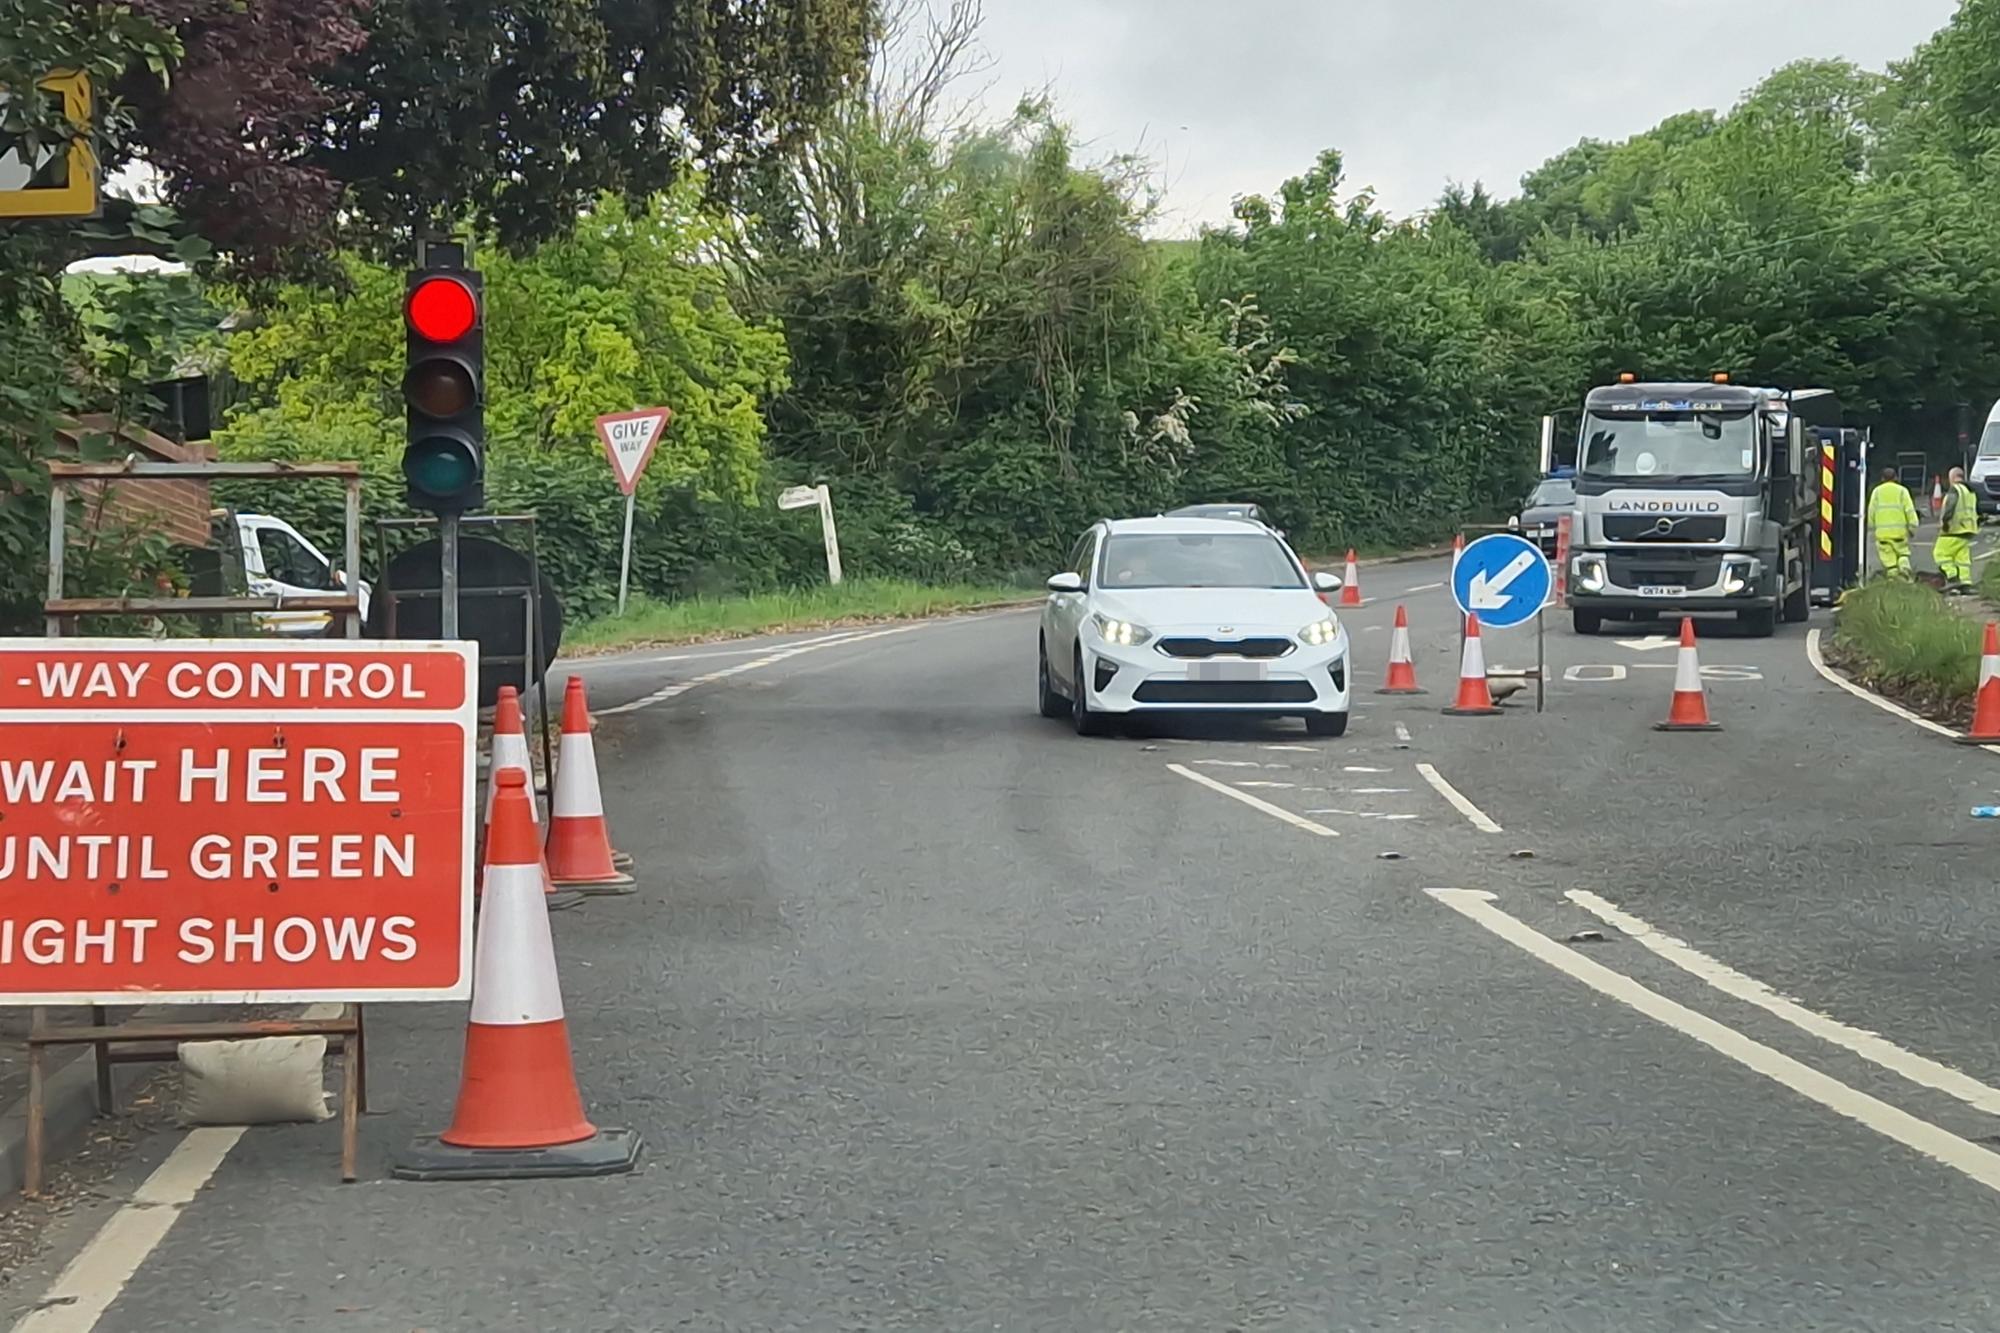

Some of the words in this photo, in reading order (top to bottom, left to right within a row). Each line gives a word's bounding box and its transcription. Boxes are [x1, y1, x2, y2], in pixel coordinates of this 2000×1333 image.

[612, 420, 649, 440] GIVE
[620, 440, 642, 453] WAY
[1608, 501, 1720, 512] LANDBUILD
[17, 662, 150, 698] -WAY
[167, 662, 426, 699] CONTROL
[0, 760, 157, 803] WAIT
[179, 748, 400, 802] HERE
[190, 834, 415, 879] GREEN
[1, 919, 158, 964] IGHT
[178, 916, 417, 963] SHOWS
